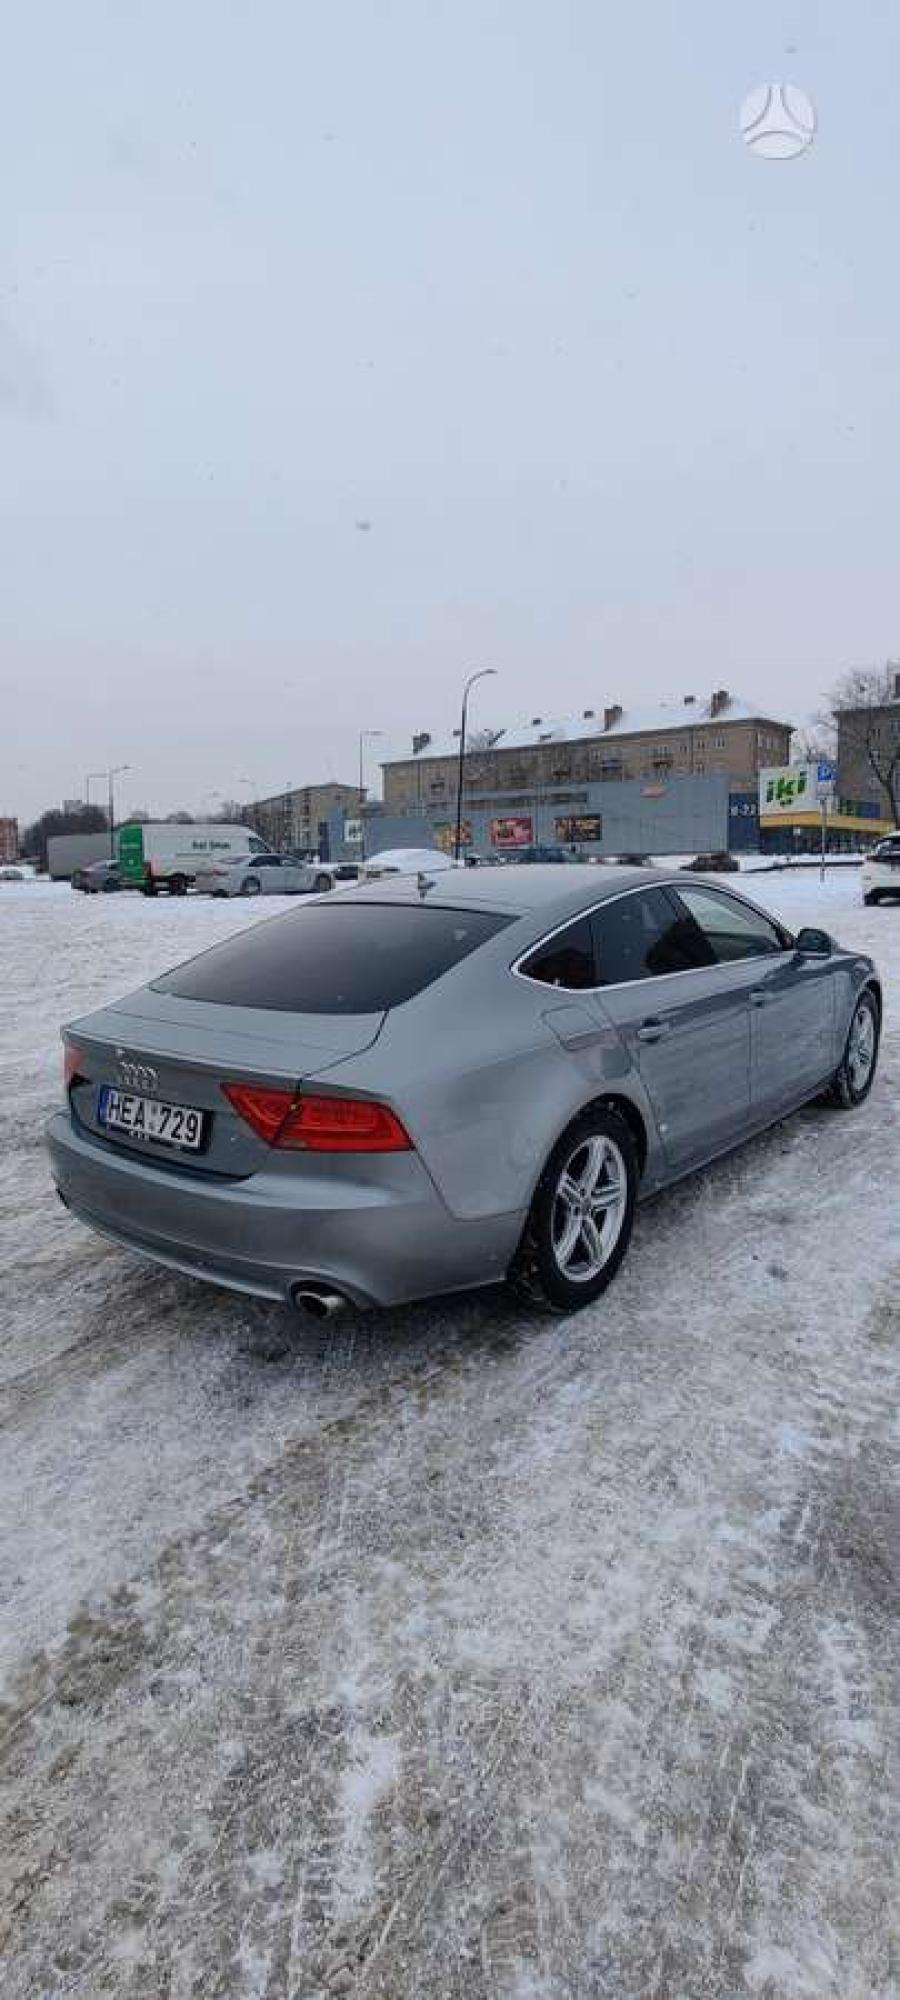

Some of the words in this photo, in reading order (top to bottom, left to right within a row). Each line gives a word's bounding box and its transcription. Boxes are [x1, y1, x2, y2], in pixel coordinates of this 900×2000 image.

[766, 770, 808, 807] iki
[108, 1088, 145, 1128] HEA
[159, 1106, 199, 1143] 729
